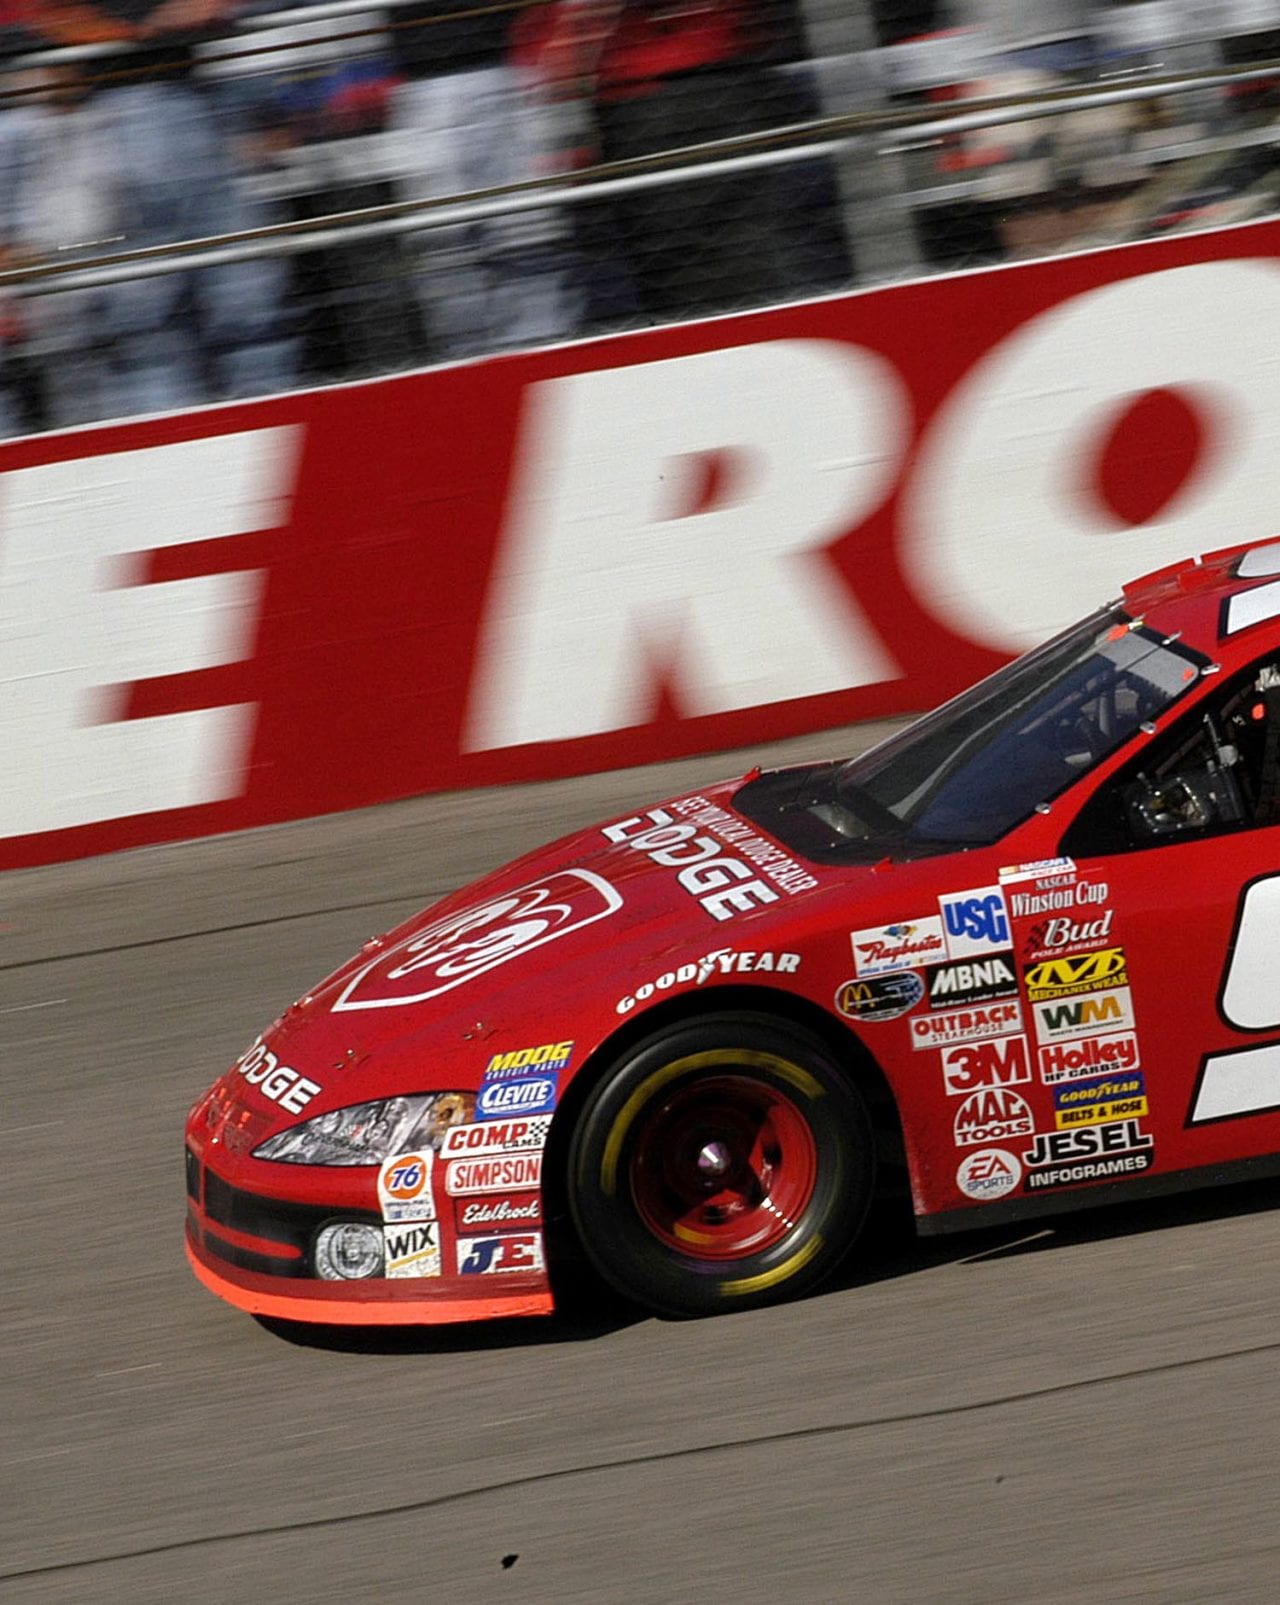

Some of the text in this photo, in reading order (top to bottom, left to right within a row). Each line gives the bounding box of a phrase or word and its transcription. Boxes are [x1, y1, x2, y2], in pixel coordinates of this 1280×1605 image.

[602, 809, 780, 921] DODGE
[762, 858, 819, 895] DEALER
[1011, 881, 1109, 917] Winston Cup
[944, 894, 1009, 944] USG
[1044, 910, 1114, 947] Bud
[616, 947, 801, 1014] GOODYEAR
[930, 959, 1016, 996] MBNA
[1093, 972, 1128, 989] WEAR
[914, 1005, 1018, 1035] OUTBACK
[1042, 996, 1121, 1029] WM
[932, 1023, 1004, 1043] STEAKHOUSE
[485, 1040, 575, 1073] MOOG
[947, 1037, 1028, 1089] 3M
[1041, 1039, 1136, 1074] Holley
[1069, 1062, 1120, 1078] CARBS
[482, 1080, 552, 1109] CLEVITE
[1060, 1081, 1140, 1103] GOODYEAR
[957, 1090, 1030, 1130] MAC
[1062, 1100, 1142, 1123] BELTS & HOSE
[449, 1122, 529, 1150] COMP
[502, 1136, 543, 1149] CAMS
[957, 1120, 1031, 1143] TOOLS
[1024, 1120, 1151, 1165] JESEL
[392, 1165, 420, 1189] 76
[455, 1158, 540, 1189] SIMPSON
[966, 1175, 1015, 1192] SPORTS
[967, 1155, 1011, 1181] EA
[1029, 1155, 1148, 1188] INFOGRAMES
[463, 1201, 540, 1225] Edelbrock
[387, 1224, 436, 1260] WIX
[461, 1235, 535, 1275] JE
